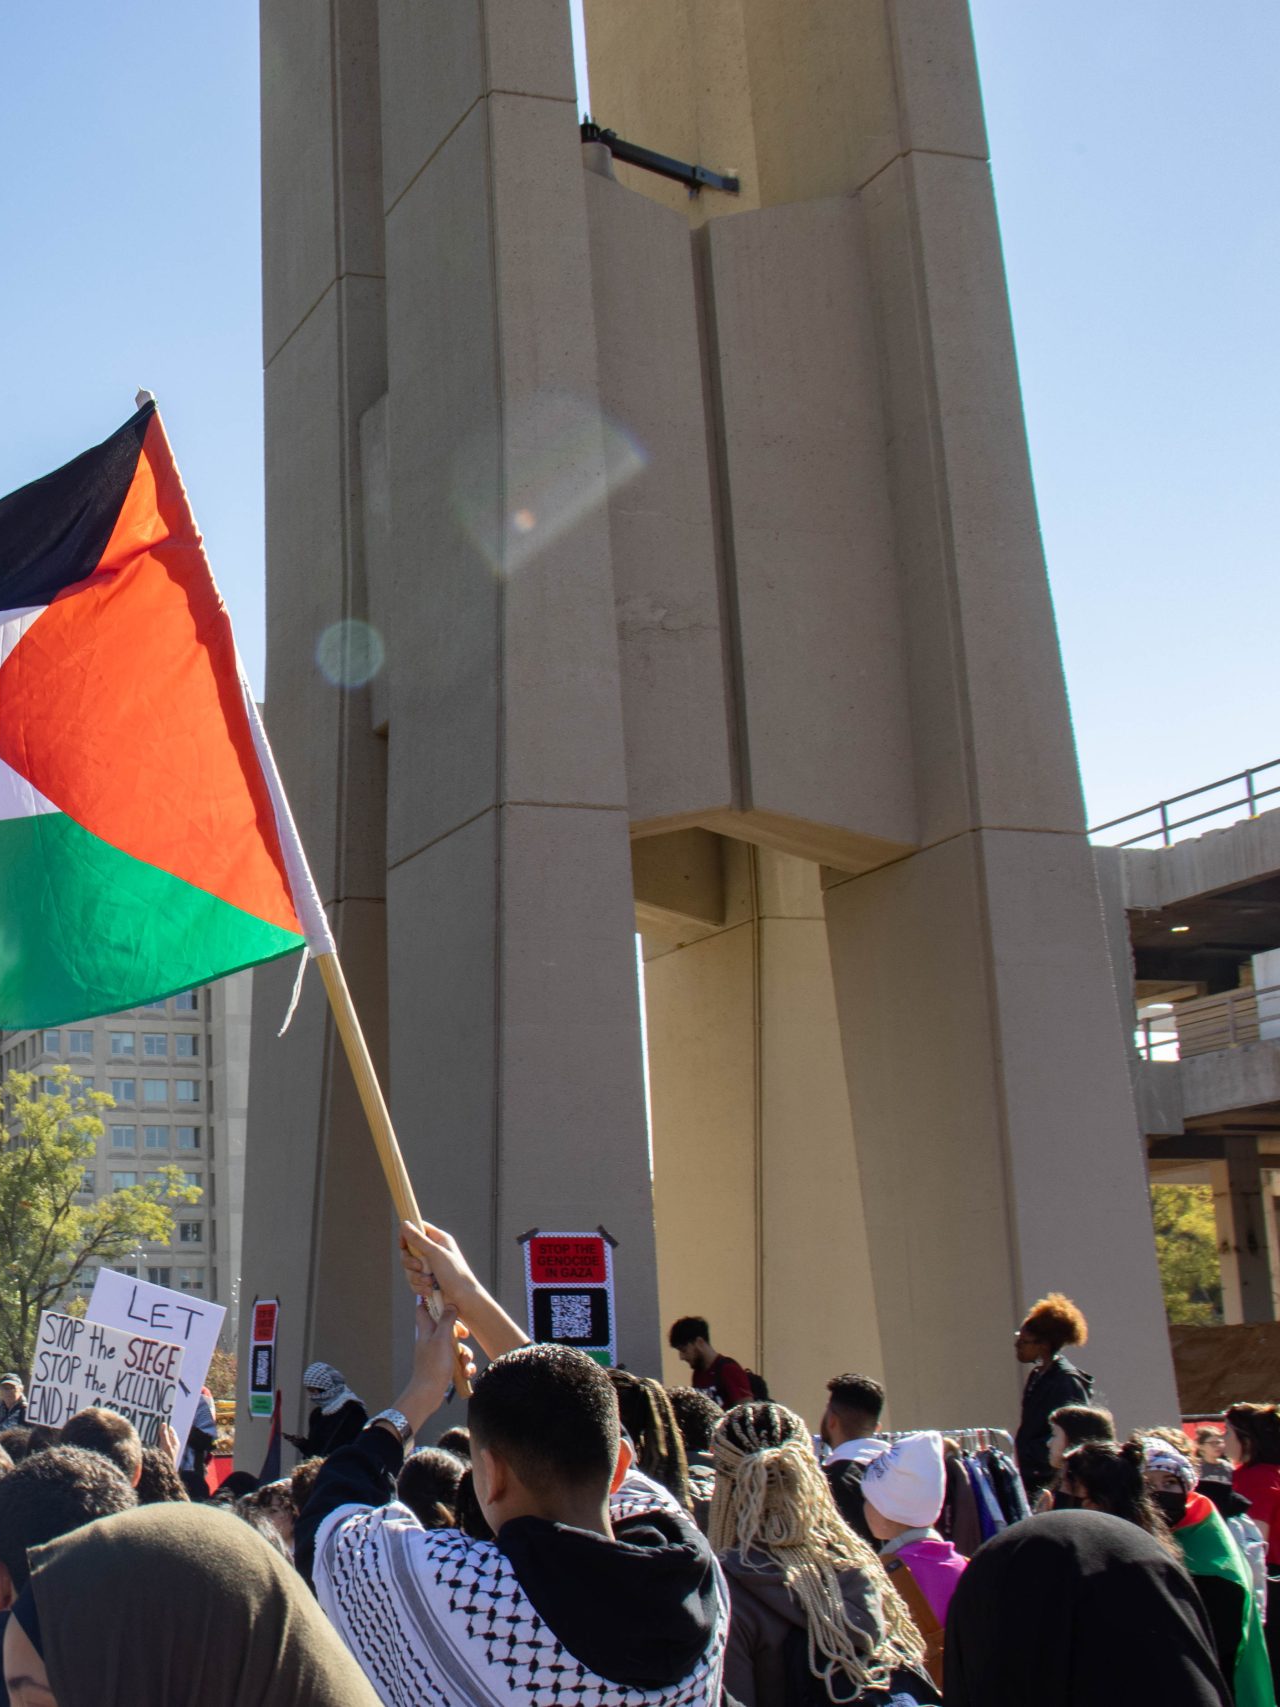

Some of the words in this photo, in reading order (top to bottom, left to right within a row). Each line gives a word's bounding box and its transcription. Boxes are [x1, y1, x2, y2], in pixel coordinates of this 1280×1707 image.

[537, 1255, 601, 1266] GENOCIDE
[540, 1243, 570, 1254] STOP
[575, 1243, 596, 1254] THE
[545, 1267, 558, 1278] IN
[560, 1267, 593, 1278] GAZA
[127, 1285, 204, 1340] LET
[42, 1313, 85, 1352] STOP
[89, 1325, 116, 1360] the
[124, 1337, 180, 1381] SIEGE
[35, 1351, 82, 1385] STOP
[84, 1364, 107, 1394] the
[112, 1369, 176, 1415] KILLING
[28, 1384, 63, 1425] END
